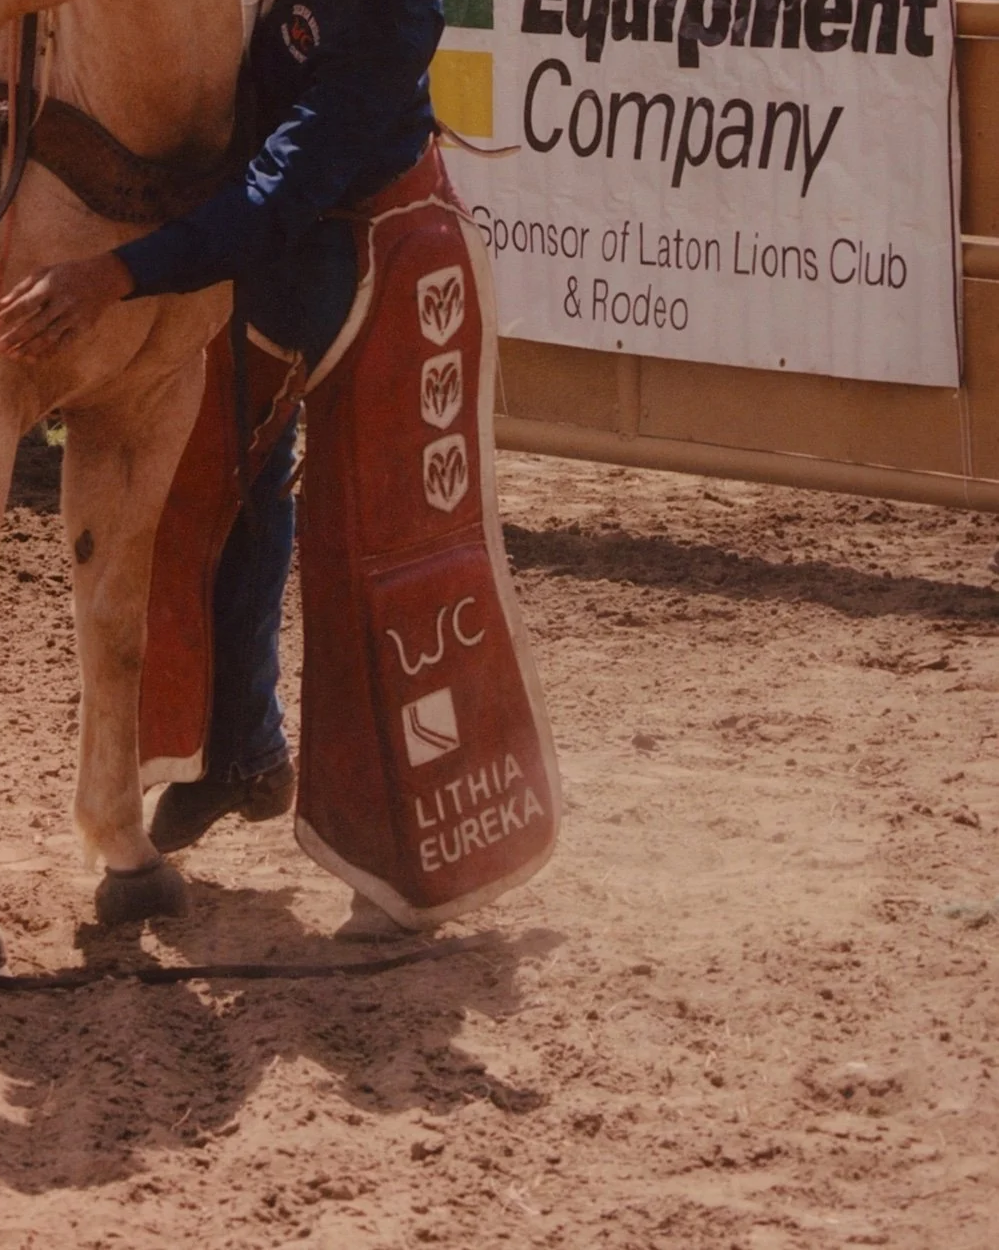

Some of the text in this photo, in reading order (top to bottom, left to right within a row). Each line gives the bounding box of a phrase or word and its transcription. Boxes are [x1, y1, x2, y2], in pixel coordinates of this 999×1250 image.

[523, 58, 844, 197] Company
[472, 205, 907, 289] Sponsor of Laton Lions Club
[563, 276, 689, 331] & Rodeo
[415, 753, 524, 829] LITHIA
[420, 786, 544, 873] EUREKA
